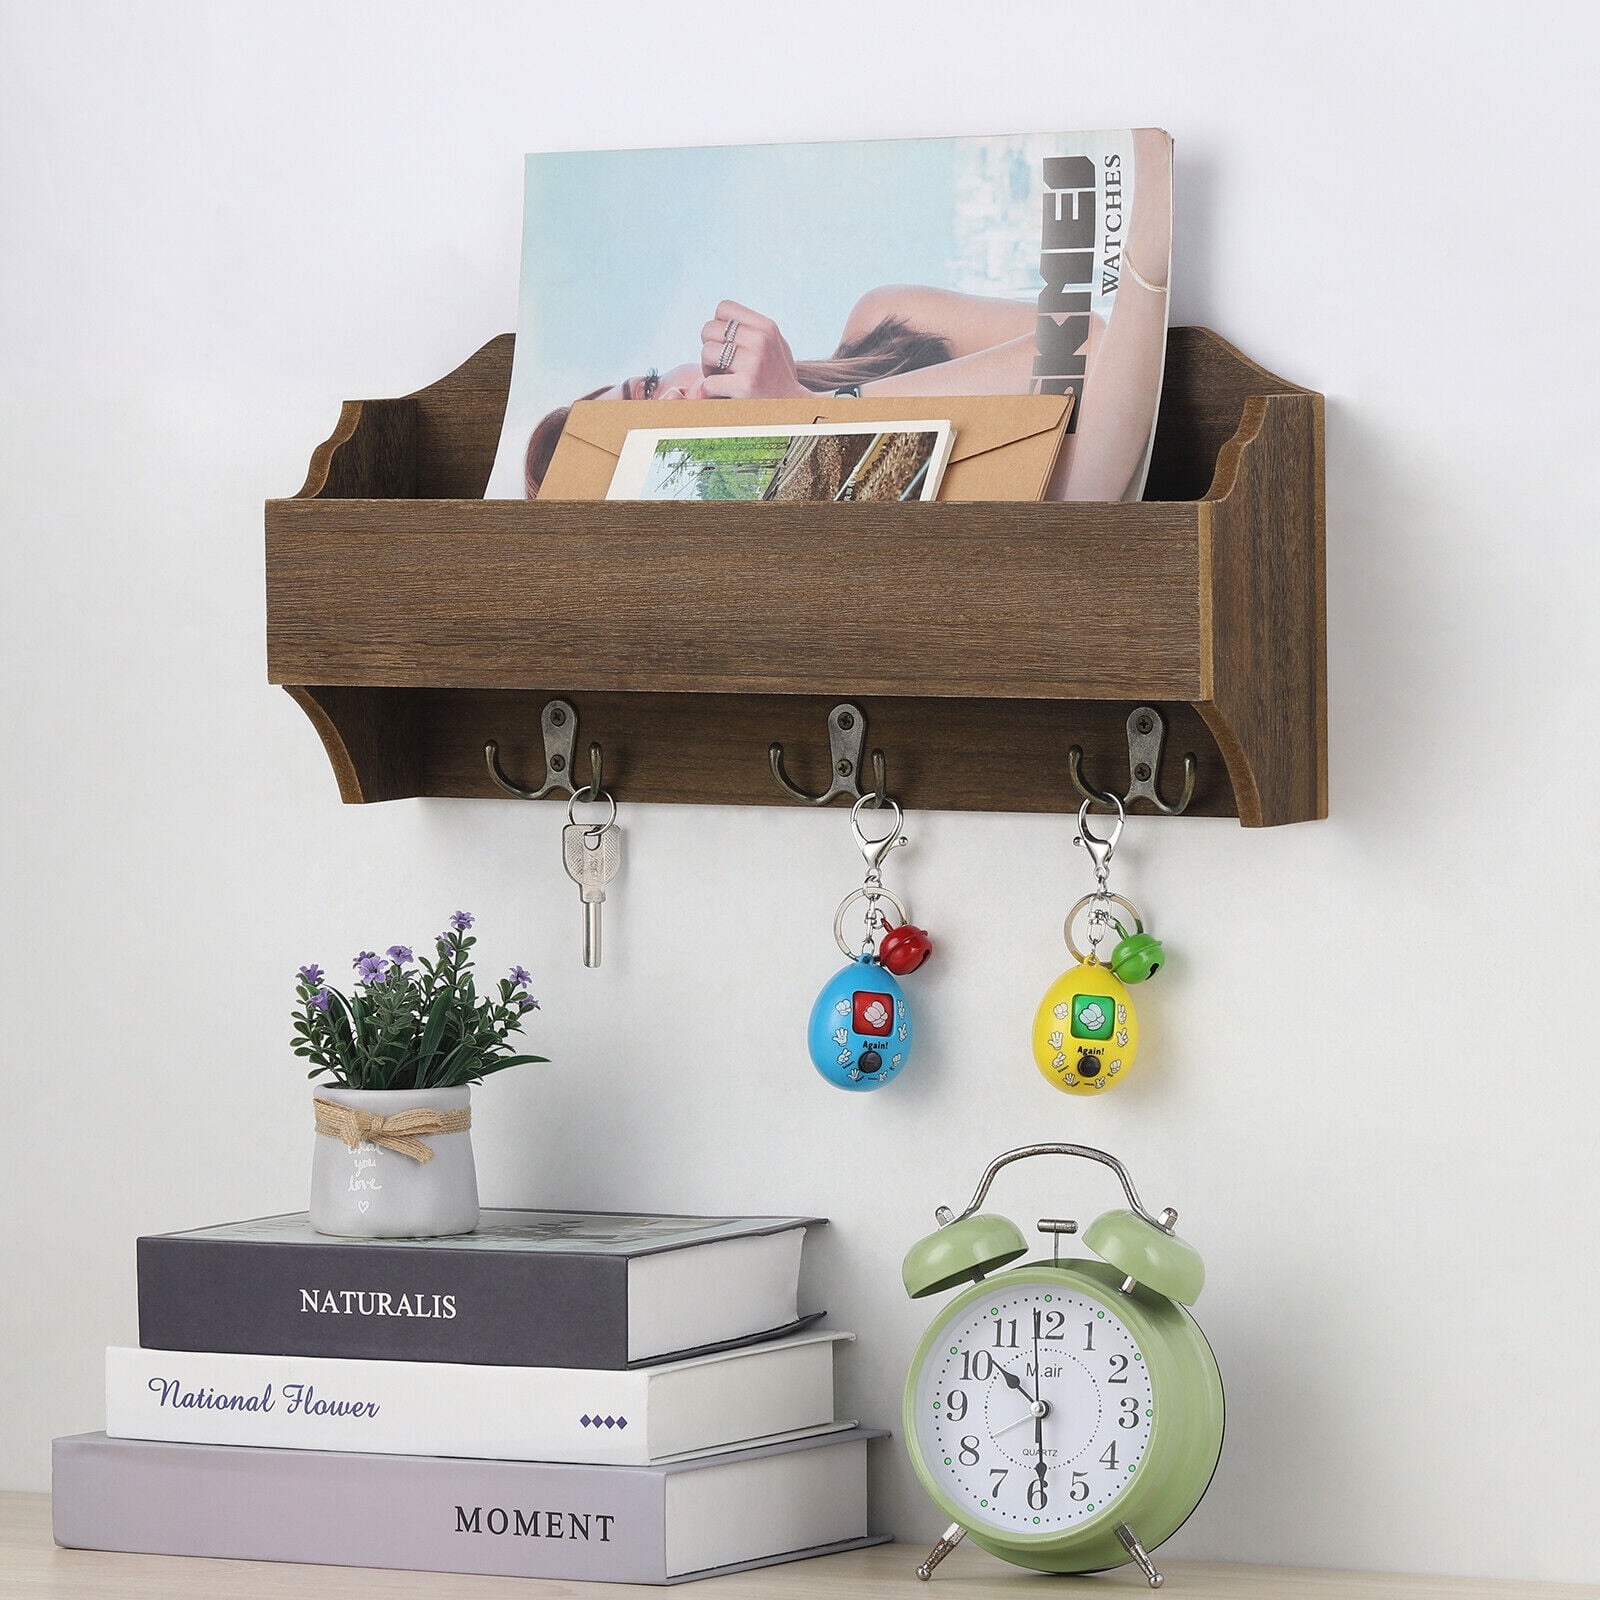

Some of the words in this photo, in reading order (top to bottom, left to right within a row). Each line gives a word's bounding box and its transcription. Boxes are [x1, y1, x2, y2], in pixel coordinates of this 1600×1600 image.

[1102, 153, 1122, 296] WATCHES
[862, 1040, 889, 1051] Again!
[1077, 1045, 1105, 1056] Again!
[347, 1175, 383, 1192] love
[354, 1158, 377, 1178] you
[299, 1288, 457, 1320] NATURALIS
[991, 1318, 1020, 1348] 11
[1031, 1310, 1065, 1341] 12
[1082, 1321, 1096, 1351] 1
[958, 1349, 994, 1381] 10
[1107, 1354, 1129, 1384] 2
[148, 1377, 276, 1413] National
[282, 1384, 381, 1418] Flower
[946, 1389, 968, 1422] 9
[1118, 1396, 1140, 1429] 3
[958, 1435, 980, 1467] 8
[1021, 1448, 1059, 1458] QUARTZ
[1099, 1439, 1120, 1471] 4
[989, 1468, 1009, 1499] 7
[1026, 1477, 1049, 1511] 6
[1069, 1471, 1090, 1502] 5
[454, 1505, 615, 1542] MOMENT
